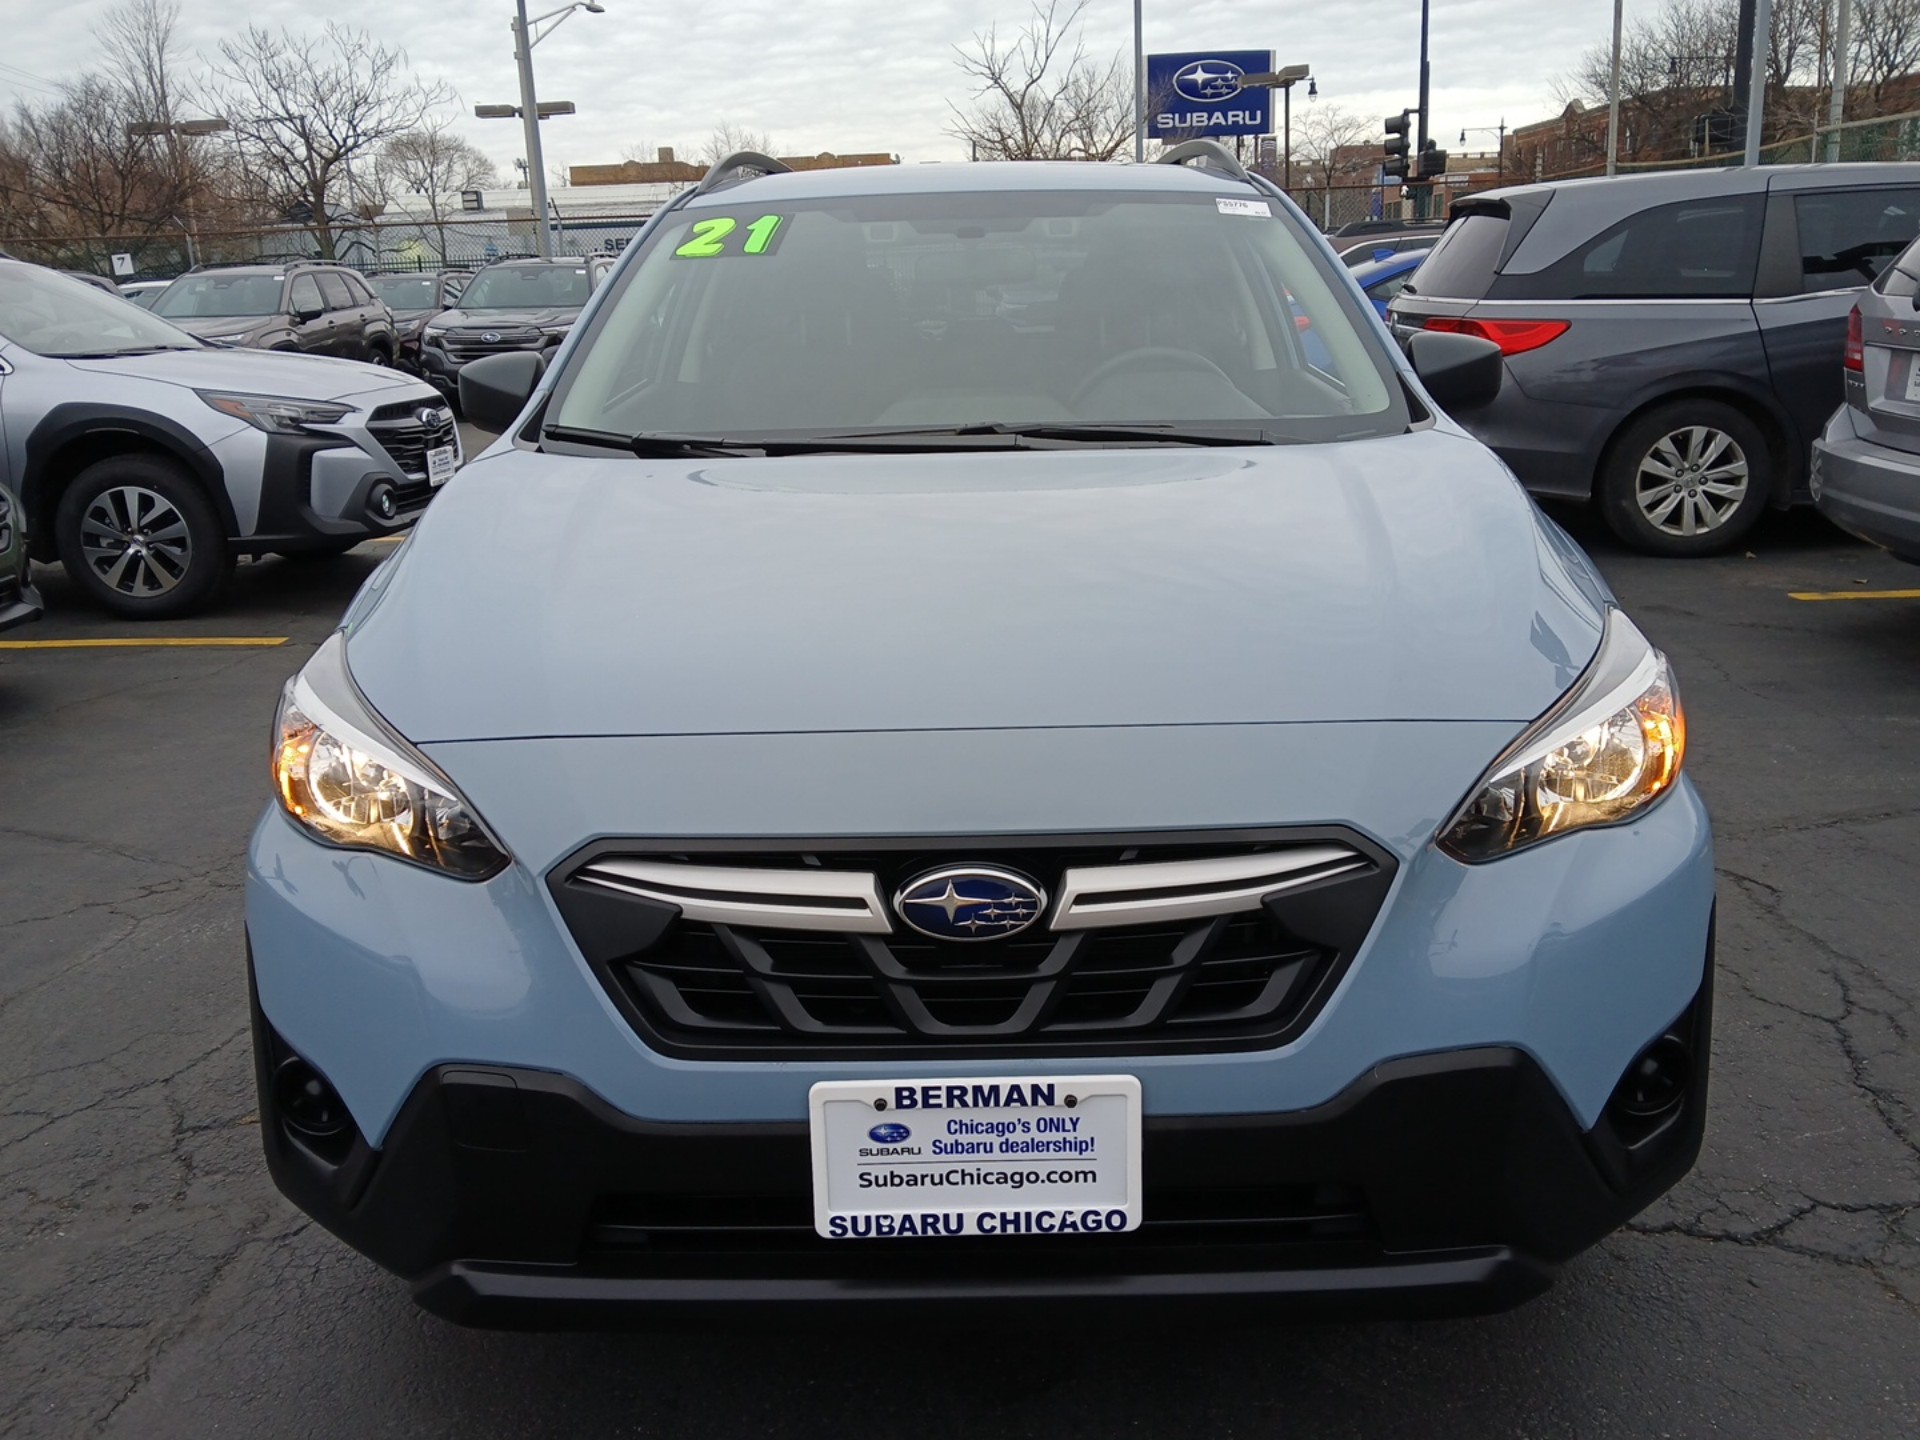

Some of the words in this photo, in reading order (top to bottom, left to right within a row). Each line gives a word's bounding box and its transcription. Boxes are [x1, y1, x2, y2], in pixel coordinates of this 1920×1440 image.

[1156, 110, 1261, 128] SUBARU
[675, 215, 784, 256] 21
[116, 256, 125, 268] 7
[894, 1083, 1056, 1110] BERMAN
[946, 1118, 1031, 1138] Chicago's
[1036, 1116, 1081, 1134] ONLY
[858, 1146, 922, 1157] SUBARU
[931, 1139, 994, 1156] Subaru
[998, 1136, 1096, 1156] dealership!
[858, 1168, 1098, 1189] SubaruChicago.com
[828, 1213, 965, 1238] SUBARU
[976, 1209, 1129, 1235] CHICAGO
